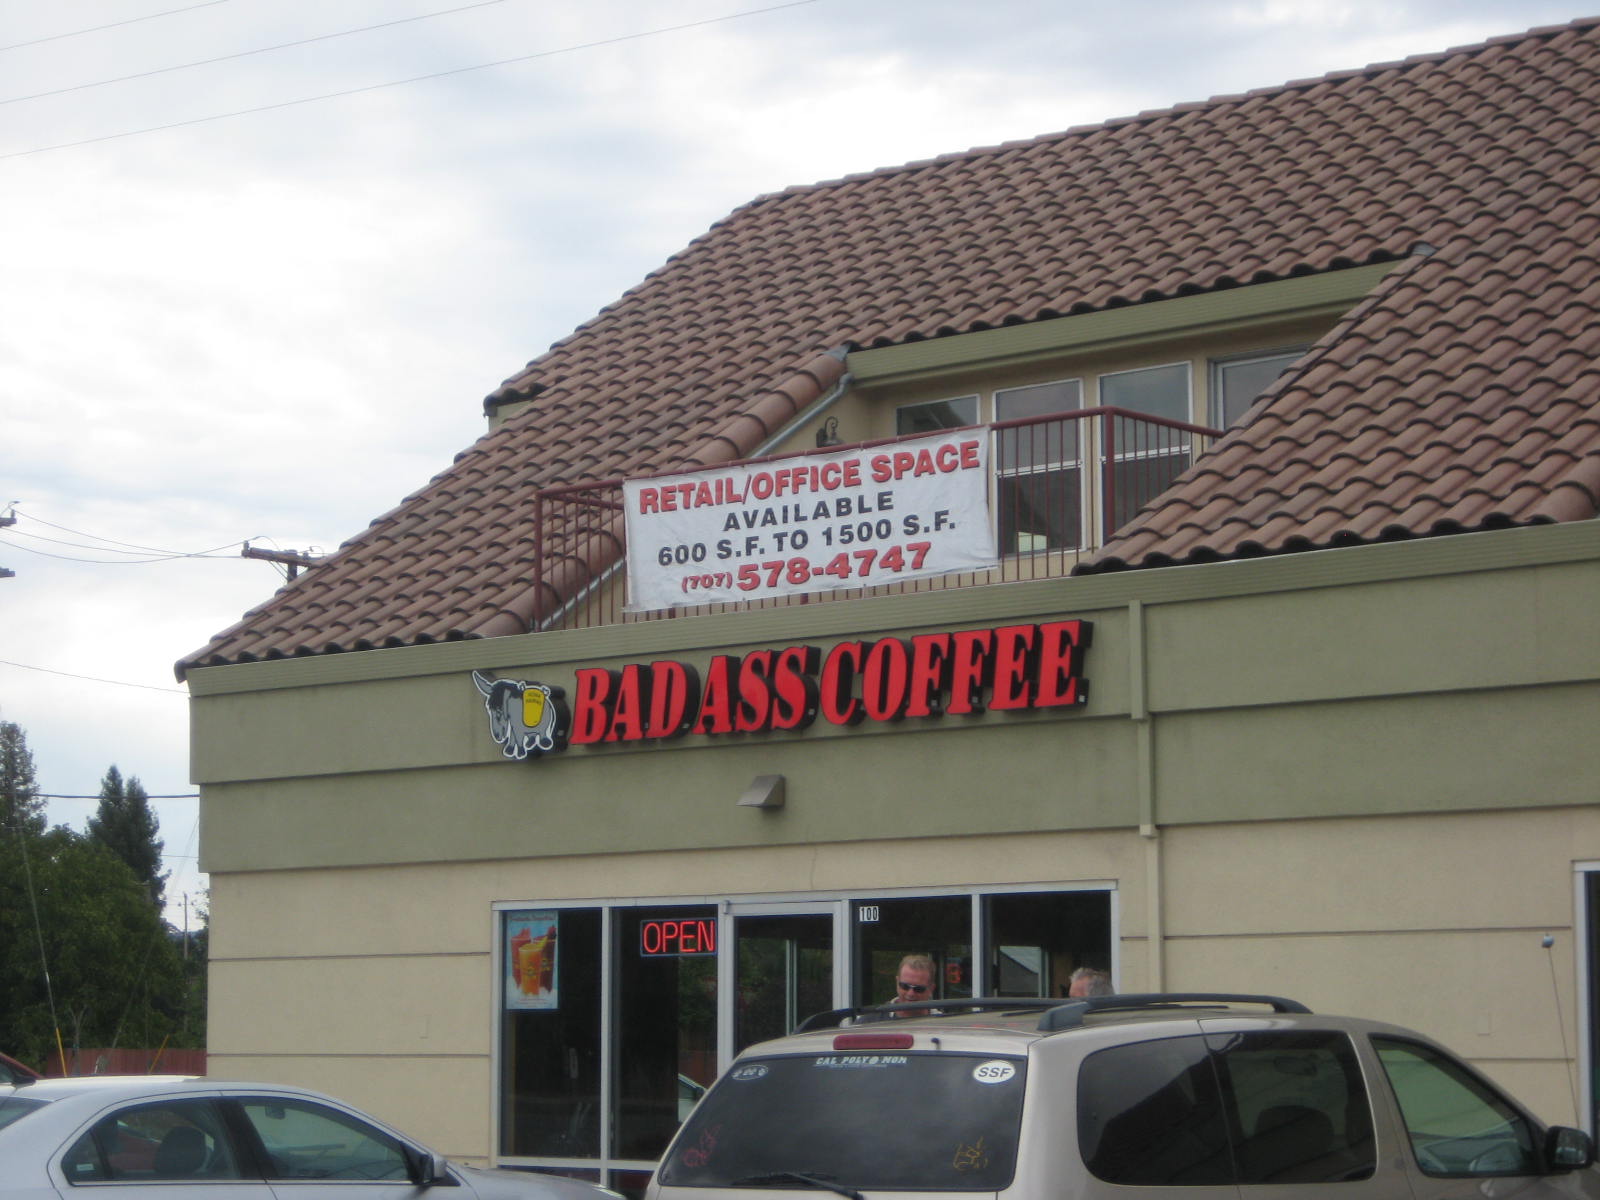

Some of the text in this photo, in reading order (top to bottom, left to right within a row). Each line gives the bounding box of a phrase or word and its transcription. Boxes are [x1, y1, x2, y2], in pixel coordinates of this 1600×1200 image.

[639, 440, 981, 514] RETAIL/OFFICE SPACE
[722, 491, 894, 532] AVAILABLE
[658, 509, 957, 567] 600 S.F. TO 1500 S.F.
[681, 541, 932, 594] (707) 578-4747
[569, 619, 1084, 745] BAD ASS COFFEE
[642, 919, 716, 954] OPEN
[859, 905, 880, 921] 100
[978, 1066, 1012, 1078] SSF
